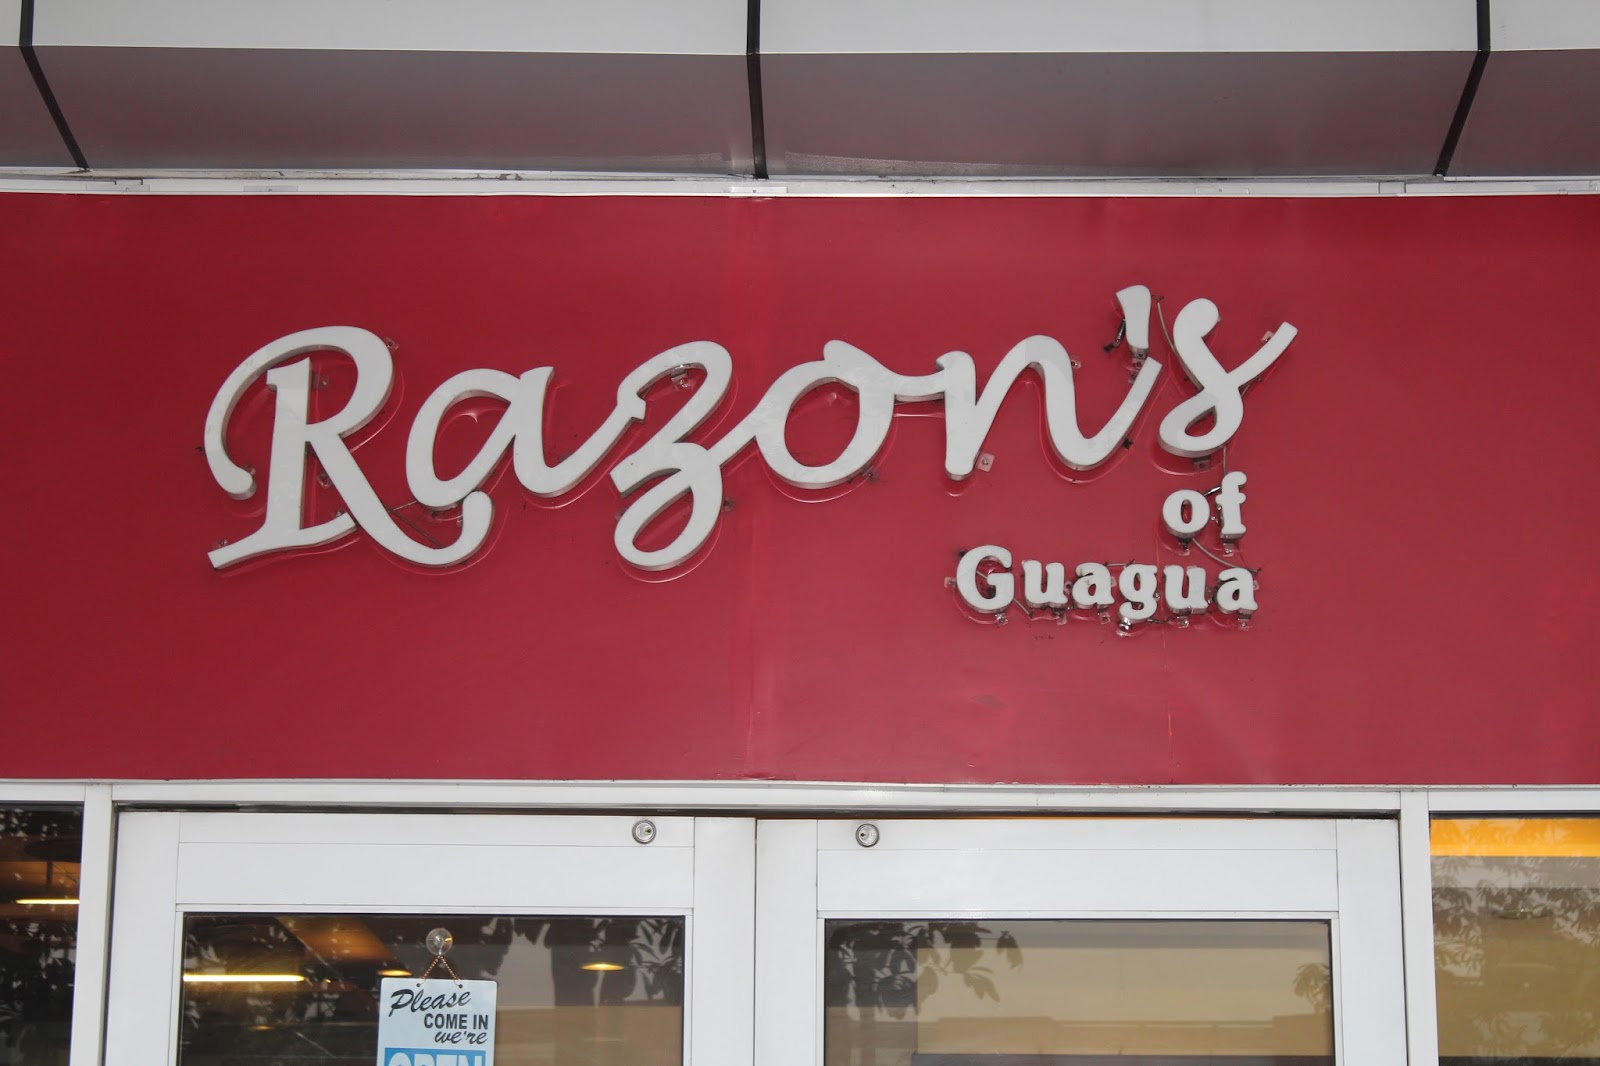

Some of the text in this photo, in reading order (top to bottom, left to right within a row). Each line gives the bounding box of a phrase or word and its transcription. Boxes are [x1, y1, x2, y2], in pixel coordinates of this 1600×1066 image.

[203, 284, 1298, 572] Razon's
[1162, 471, 1247, 540] of
[956, 545, 1259, 623] Guagua
[388, 988, 472, 1018] Please
[424, 1013, 489, 1030] COME IN
[434, 1030, 488, 1045] we're
